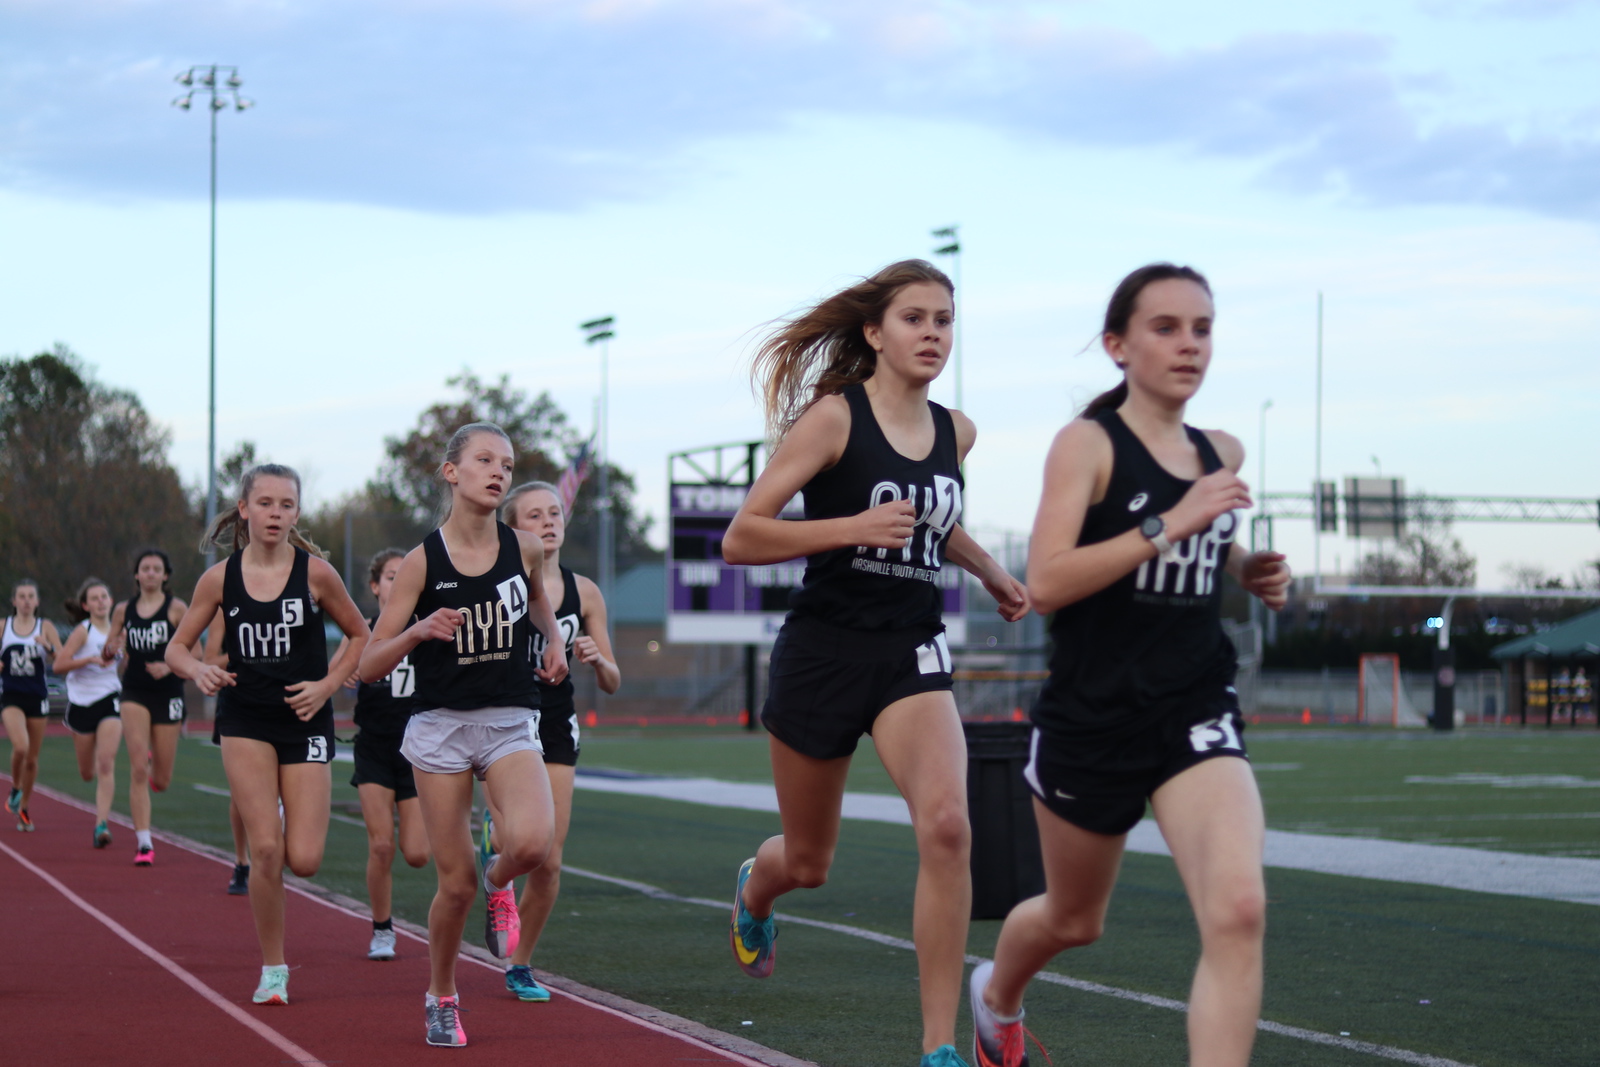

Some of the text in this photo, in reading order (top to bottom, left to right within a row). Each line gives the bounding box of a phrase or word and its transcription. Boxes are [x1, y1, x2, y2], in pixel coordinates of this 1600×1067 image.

[943, 482, 955, 529] 1
[851, 557, 891, 576] NASHVILLE
[891, 563, 914, 579] YOUTH
[509, 580, 525, 615] 4
[284, 600, 297, 626] 5
[455, 599, 514, 654] NYA
[155, 623, 165, 642] 9
[238, 622, 291, 658] NYA
[561, 619, 574, 649] 2
[397, 668, 410, 695] 7
[311, 737, 322, 759] 5
